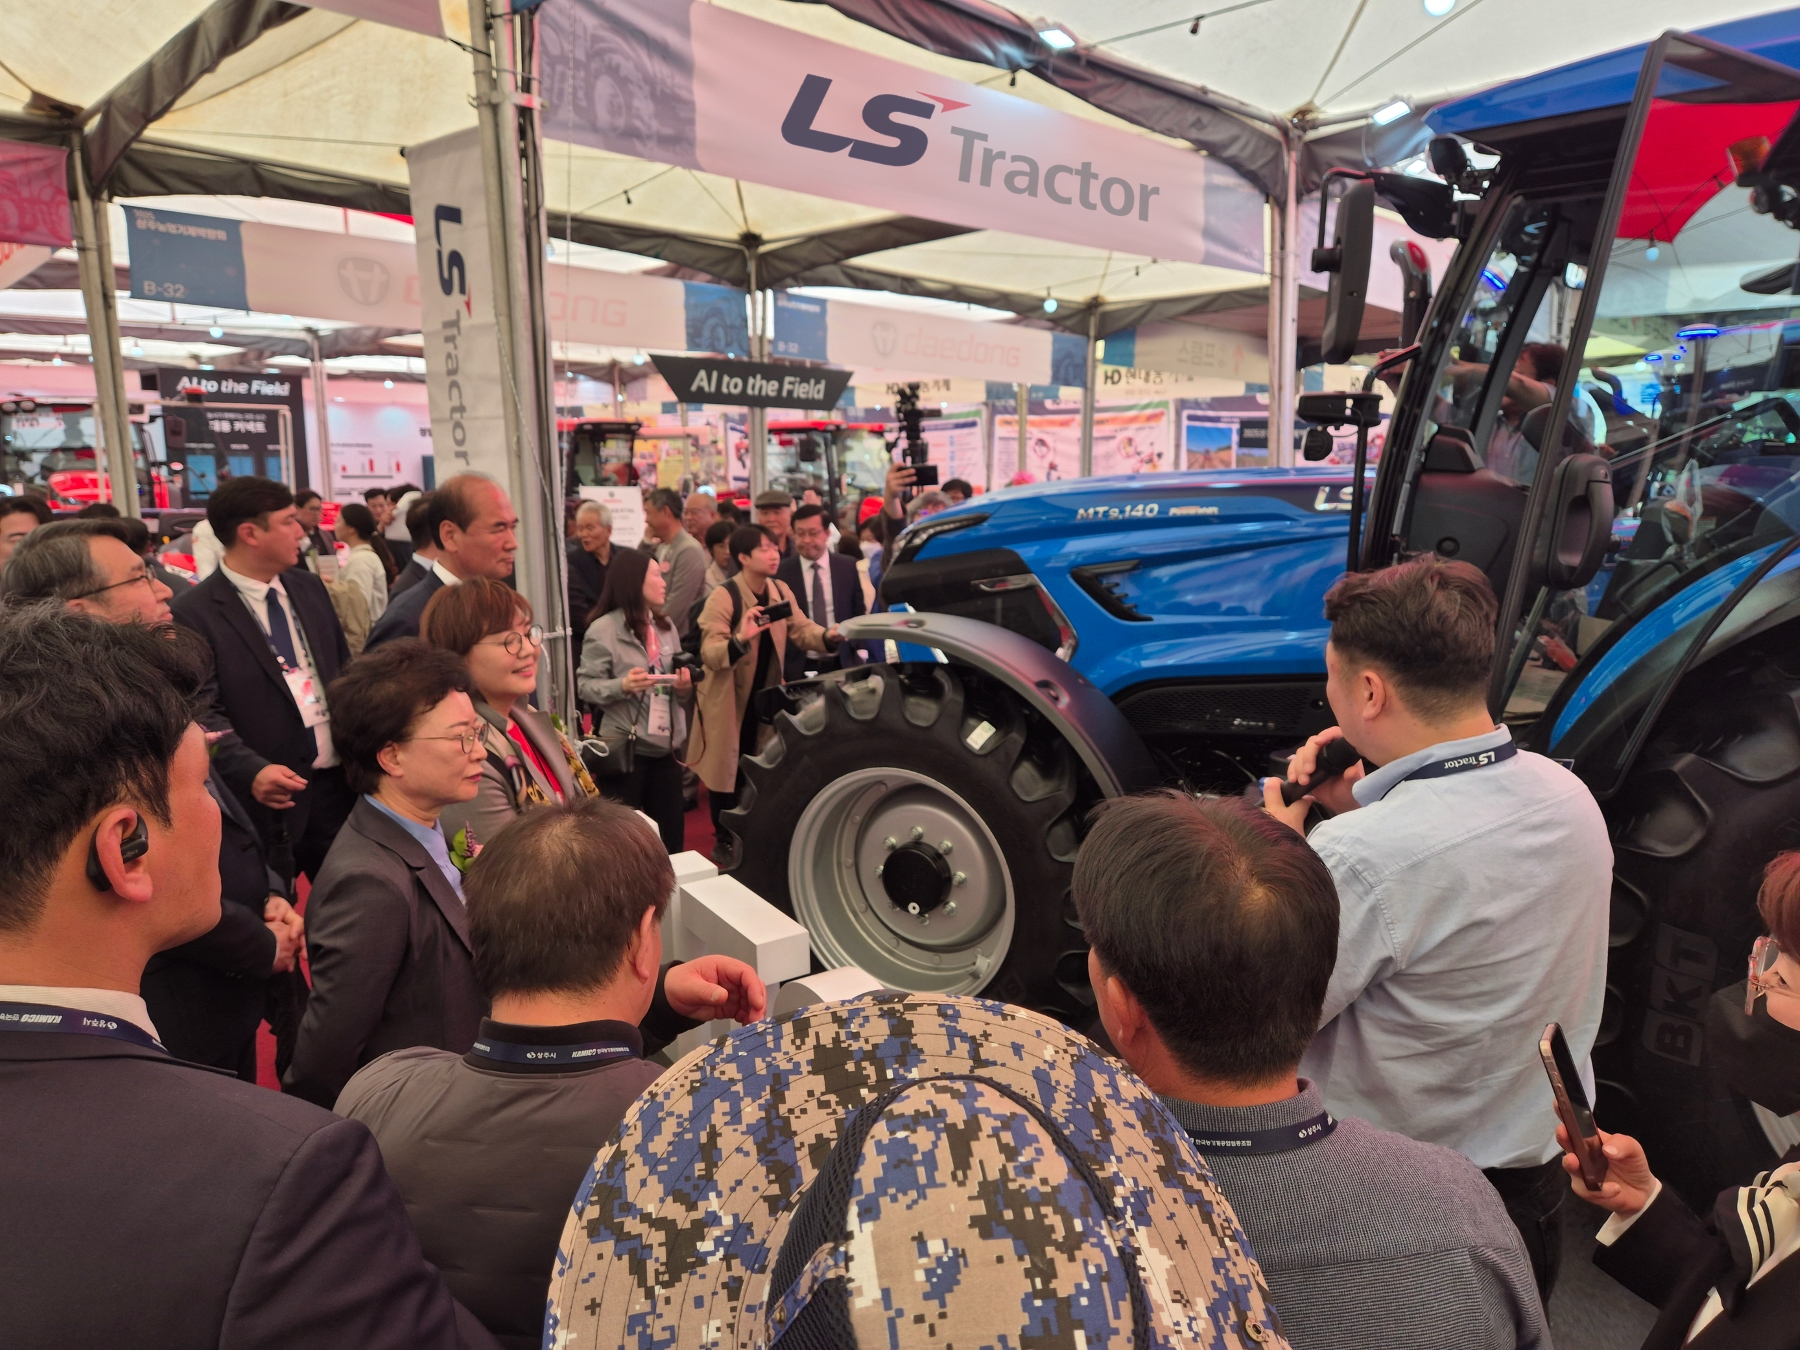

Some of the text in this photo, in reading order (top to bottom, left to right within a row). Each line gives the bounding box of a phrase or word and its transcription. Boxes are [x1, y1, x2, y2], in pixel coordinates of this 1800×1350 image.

[781, 73, 1160, 222] LS Tractor
[143, 280, 185, 298] B-32
[434, 203, 470, 466] LS Tractor
[220, 378, 248, 395] the
[251, 379, 291, 397] Field
[690, 368, 827, 401] AI to the Field
[1443, 751, 1496, 770] LS Tractor
[20, 1013, 63, 1024] KAMICO
[82, 1016, 107, 1028] 상주시
[536, 1051, 557, 1060] 상주시
